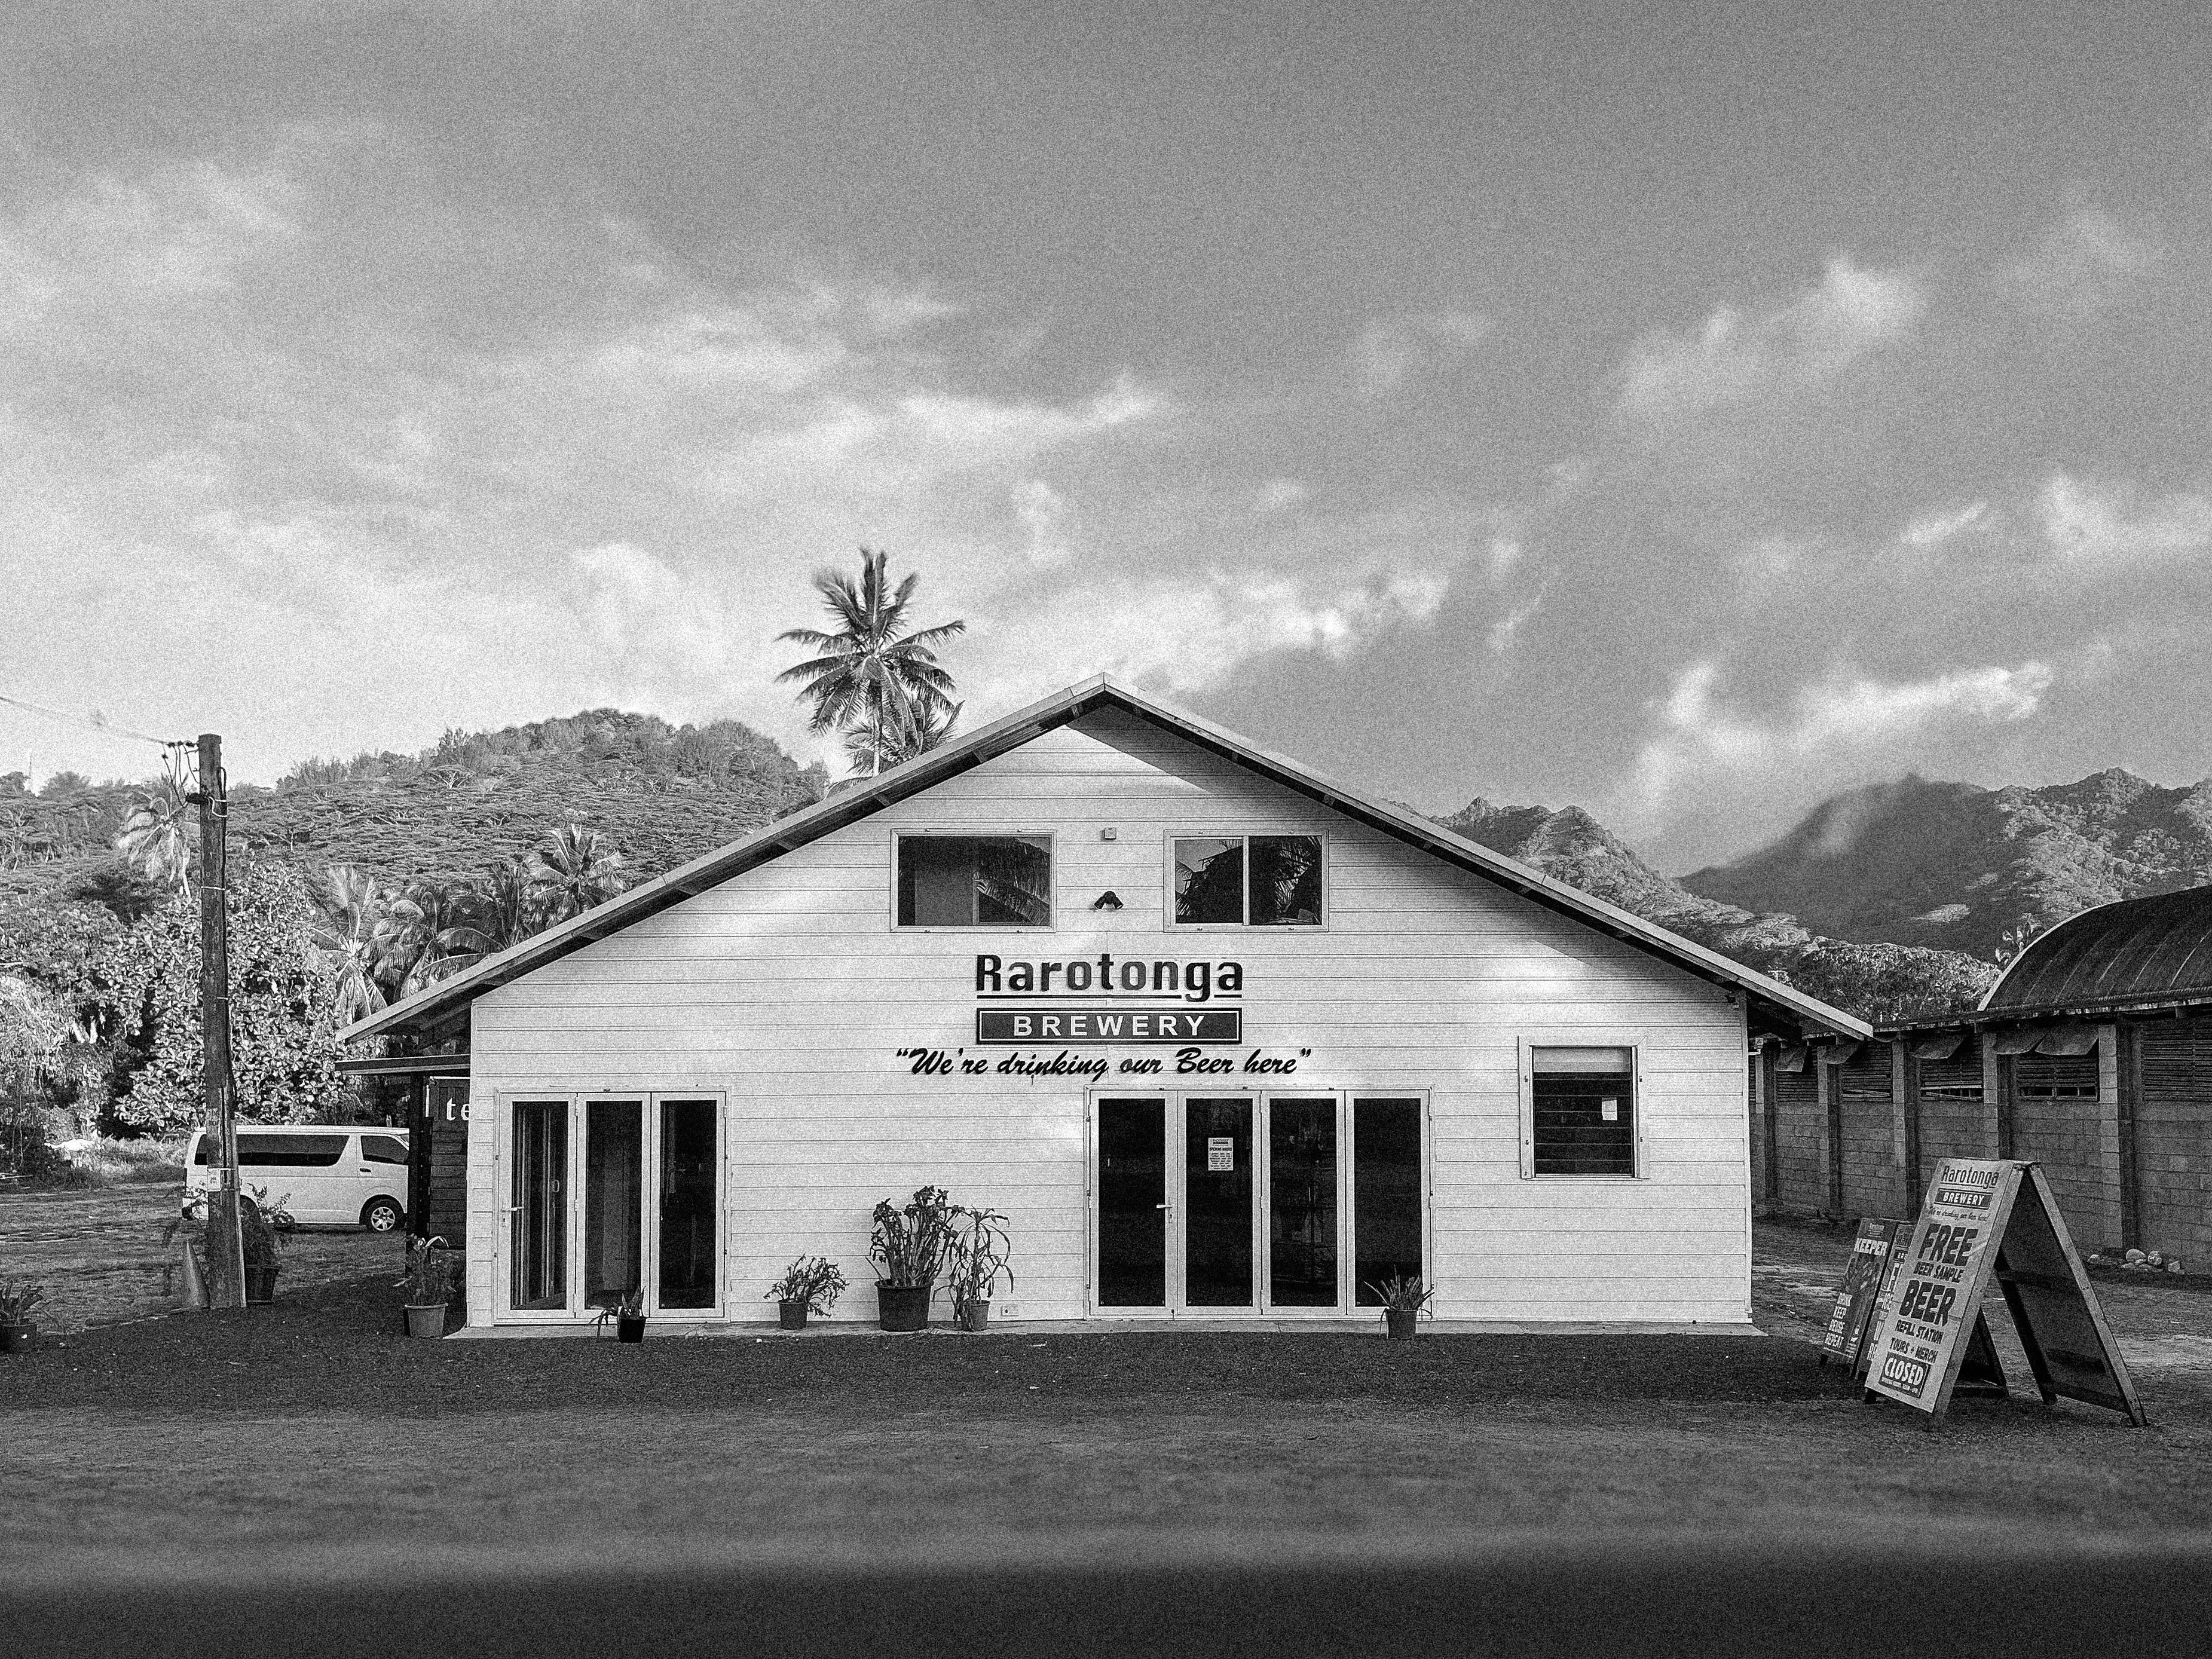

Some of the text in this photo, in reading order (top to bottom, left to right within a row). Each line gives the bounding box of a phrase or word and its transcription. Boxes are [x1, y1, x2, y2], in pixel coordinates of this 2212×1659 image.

[976, 954, 1243, 1002] Rarotonga
[1014, 1015, 1205, 1036] BREWERY
[997, 1049, 1109, 1082] drinking
[1119, 1058, 1163, 1074] our
[1176, 1046, 1234, 1074] Beer
[1942, 1166, 1999, 1189] Rarotonga
[1943, 1192, 1984, 1205] BREWERY
[1853, 1238, 1888, 1256] KEEPER
[1917, 1223, 1978, 1266] FREE
[1913, 1261, 1934, 1277] BEER
[1933, 1265, 1965, 1284] SAMPLE
[1833, 1305, 1847, 1320] KEEP
[1899, 1279, 1956, 1327] BEER
[1829, 1318, 1846, 1334] REUSE
[1895, 1320, 1916, 1337] REFILL
[1916, 1326, 1944, 1345] STATION
[1825, 1332, 1844, 1348] REPEAT
[1889, 1337, 1910, 1355] TOURS
[1915, 1345, 1938, 1364] MERCH
[1884, 1357, 1924, 1386] CLOSED
